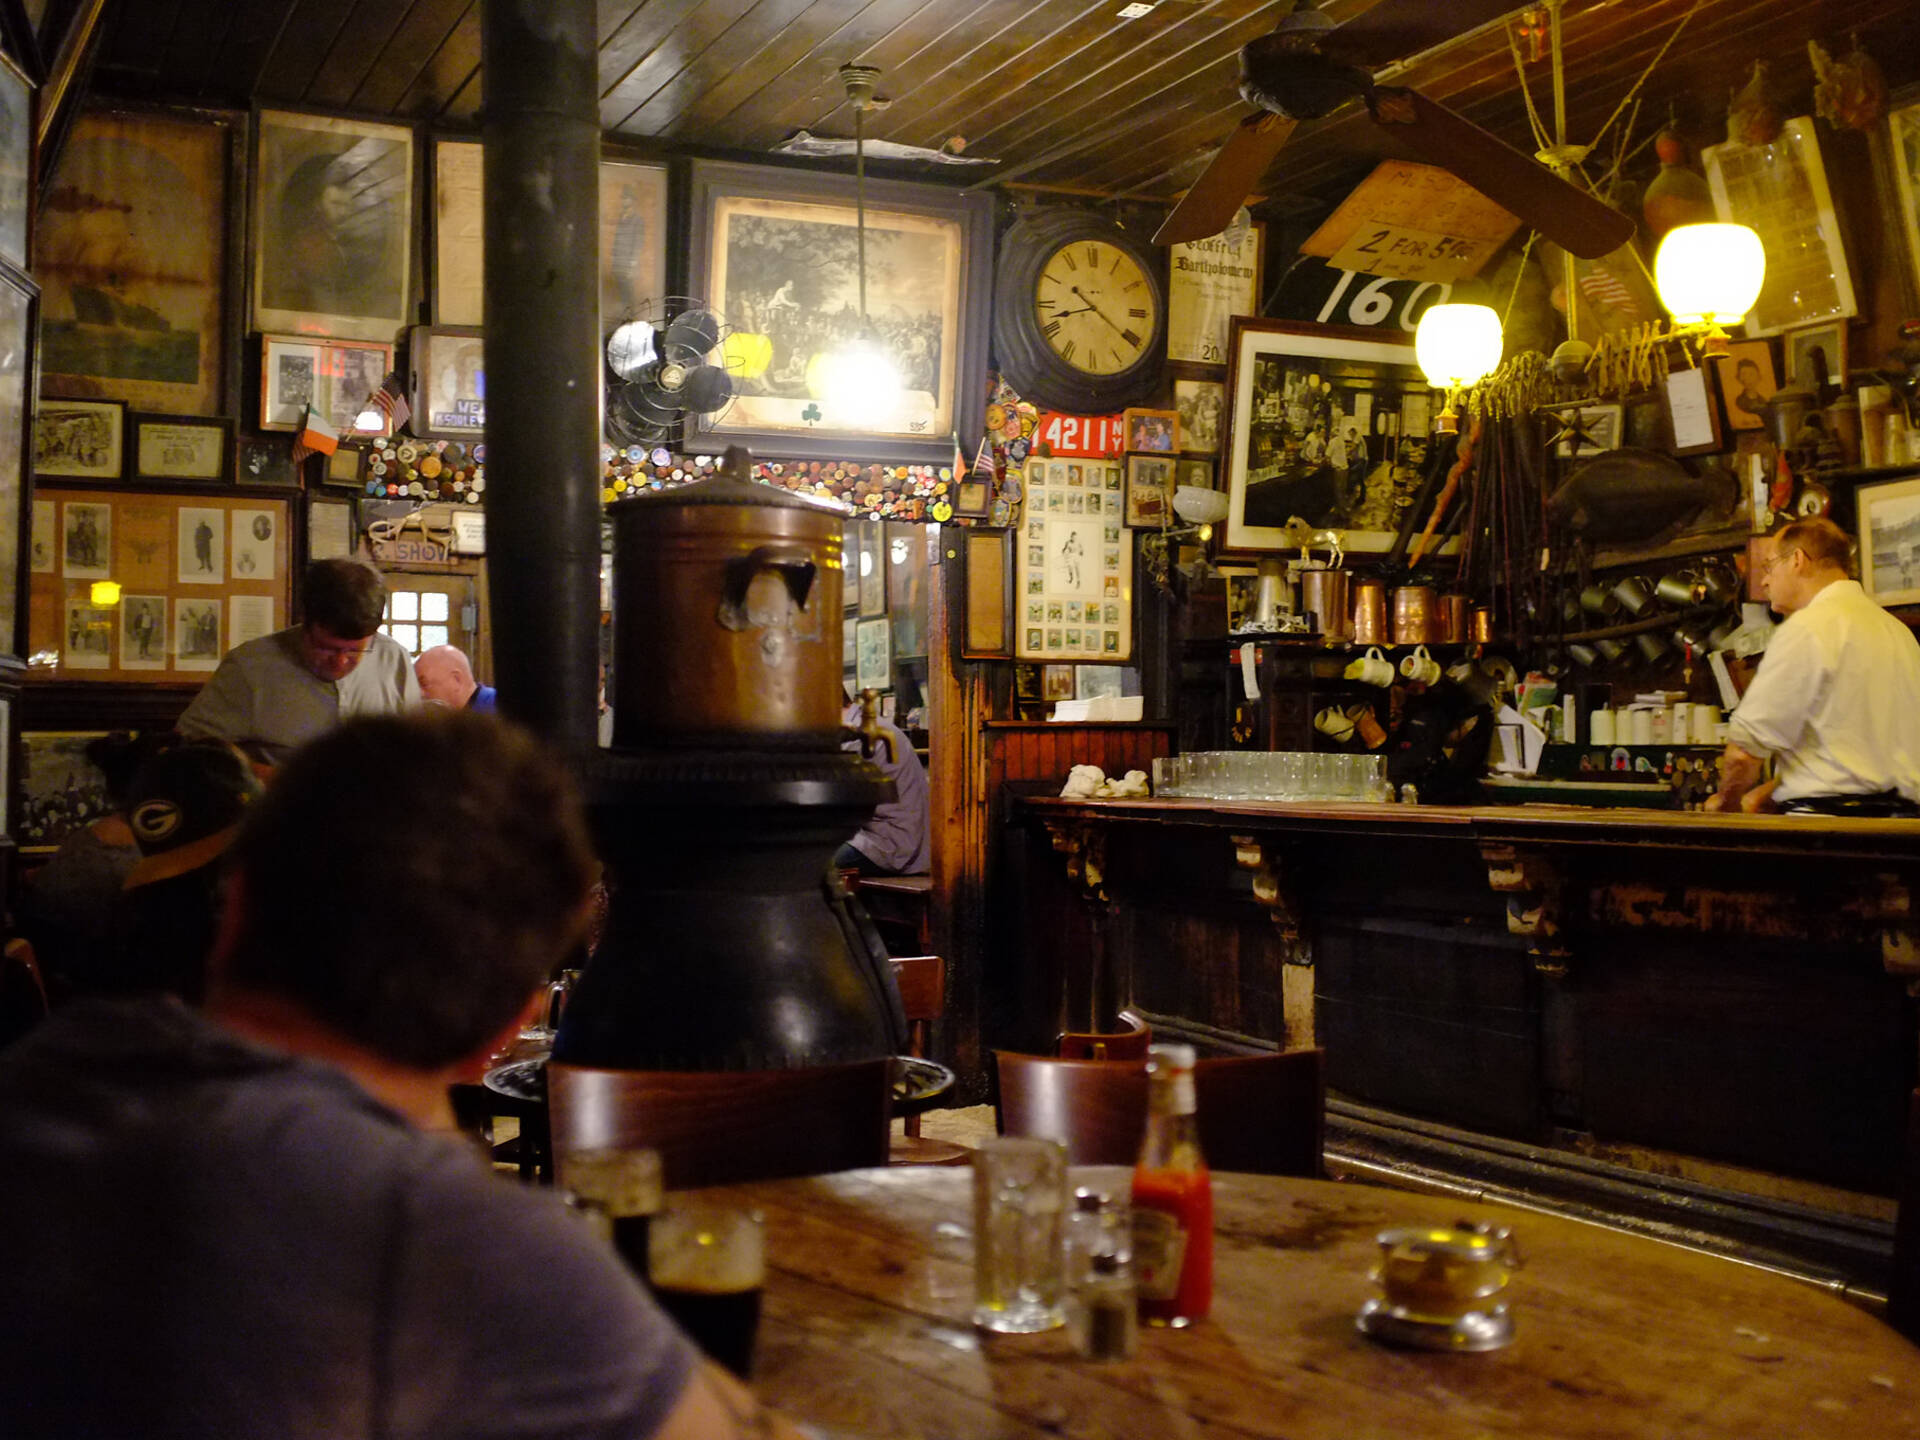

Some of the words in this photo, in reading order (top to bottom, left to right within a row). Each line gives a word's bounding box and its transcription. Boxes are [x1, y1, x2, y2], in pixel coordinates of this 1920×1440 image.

[1357, 230, 1391, 254] 2
[1390, 238, 1429, 257] FOR
[1202, 344, 1219, 362] 20
